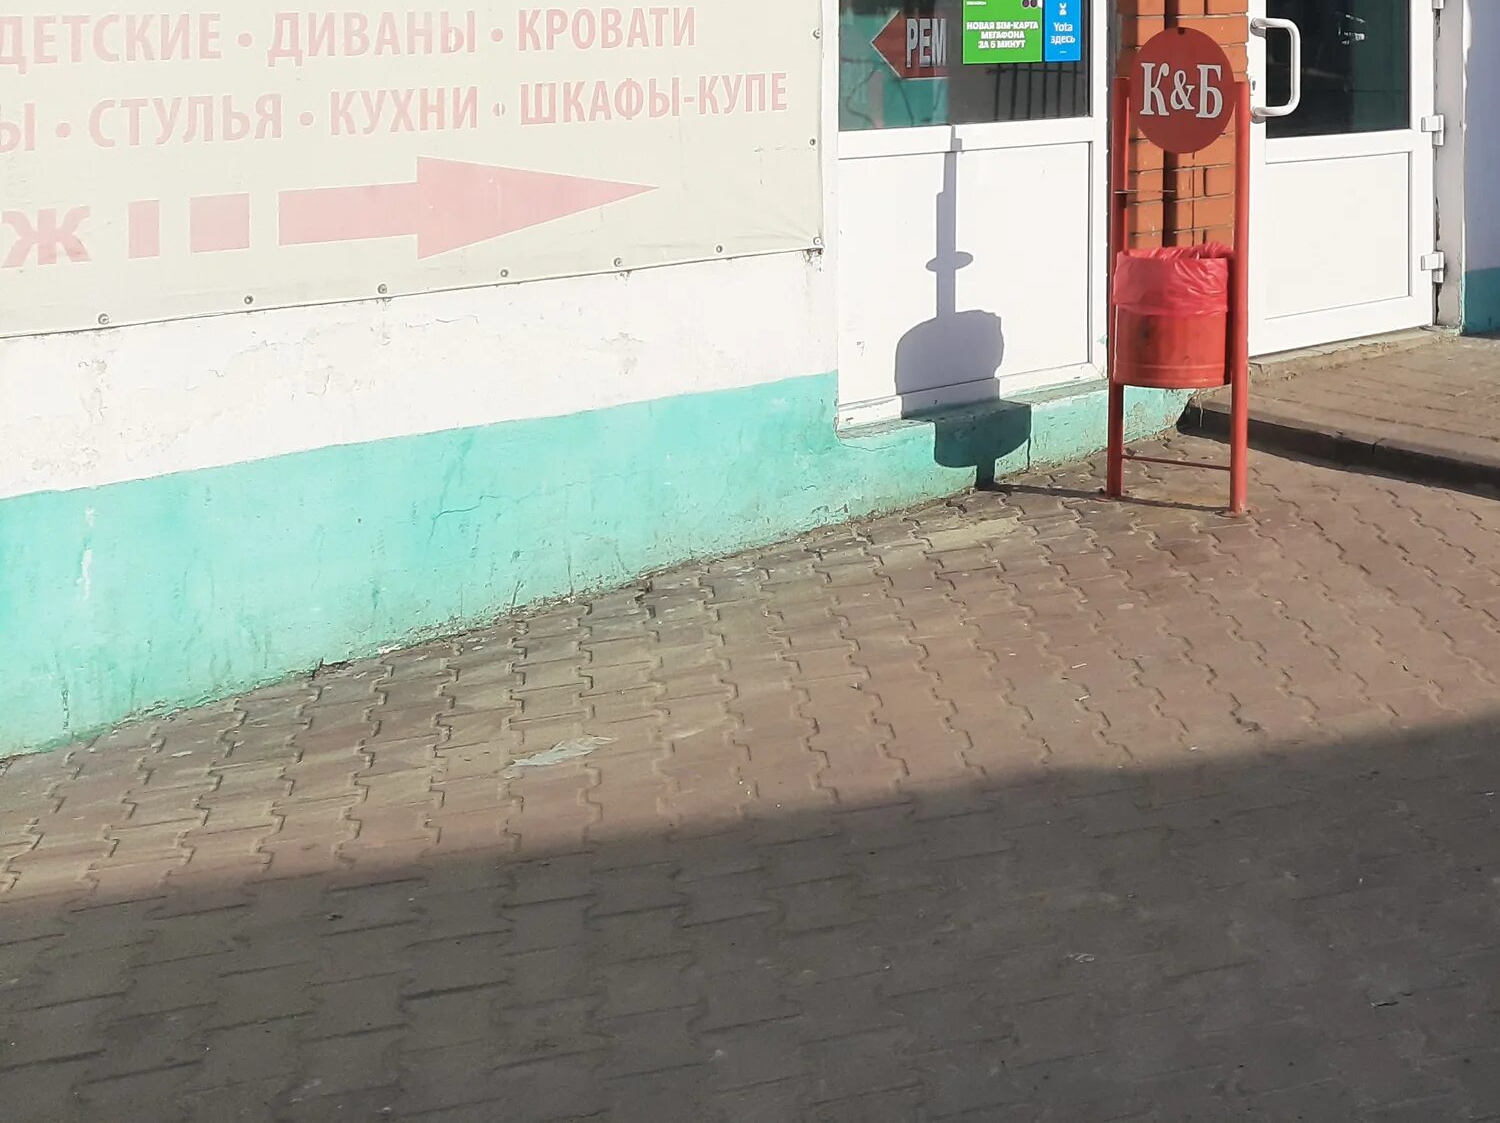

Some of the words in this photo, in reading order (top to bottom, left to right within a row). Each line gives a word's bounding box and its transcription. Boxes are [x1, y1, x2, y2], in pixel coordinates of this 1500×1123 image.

[0, 13, 222, 75] ДЕТСКИЕ
[267, 10, 477, 68] ДИВАНЫ
[516, 5, 697, 53] КРОВАТИ
[1053, 22, 1073, 32] Yota
[87, 92, 284, 149] СТУЛЬЯ
[328, 86, 479, 137] КУХНИ
[519, 72, 789, 127] ШКАФЫ-КУПЕ
[1140, 62, 1223, 118] К&Б
